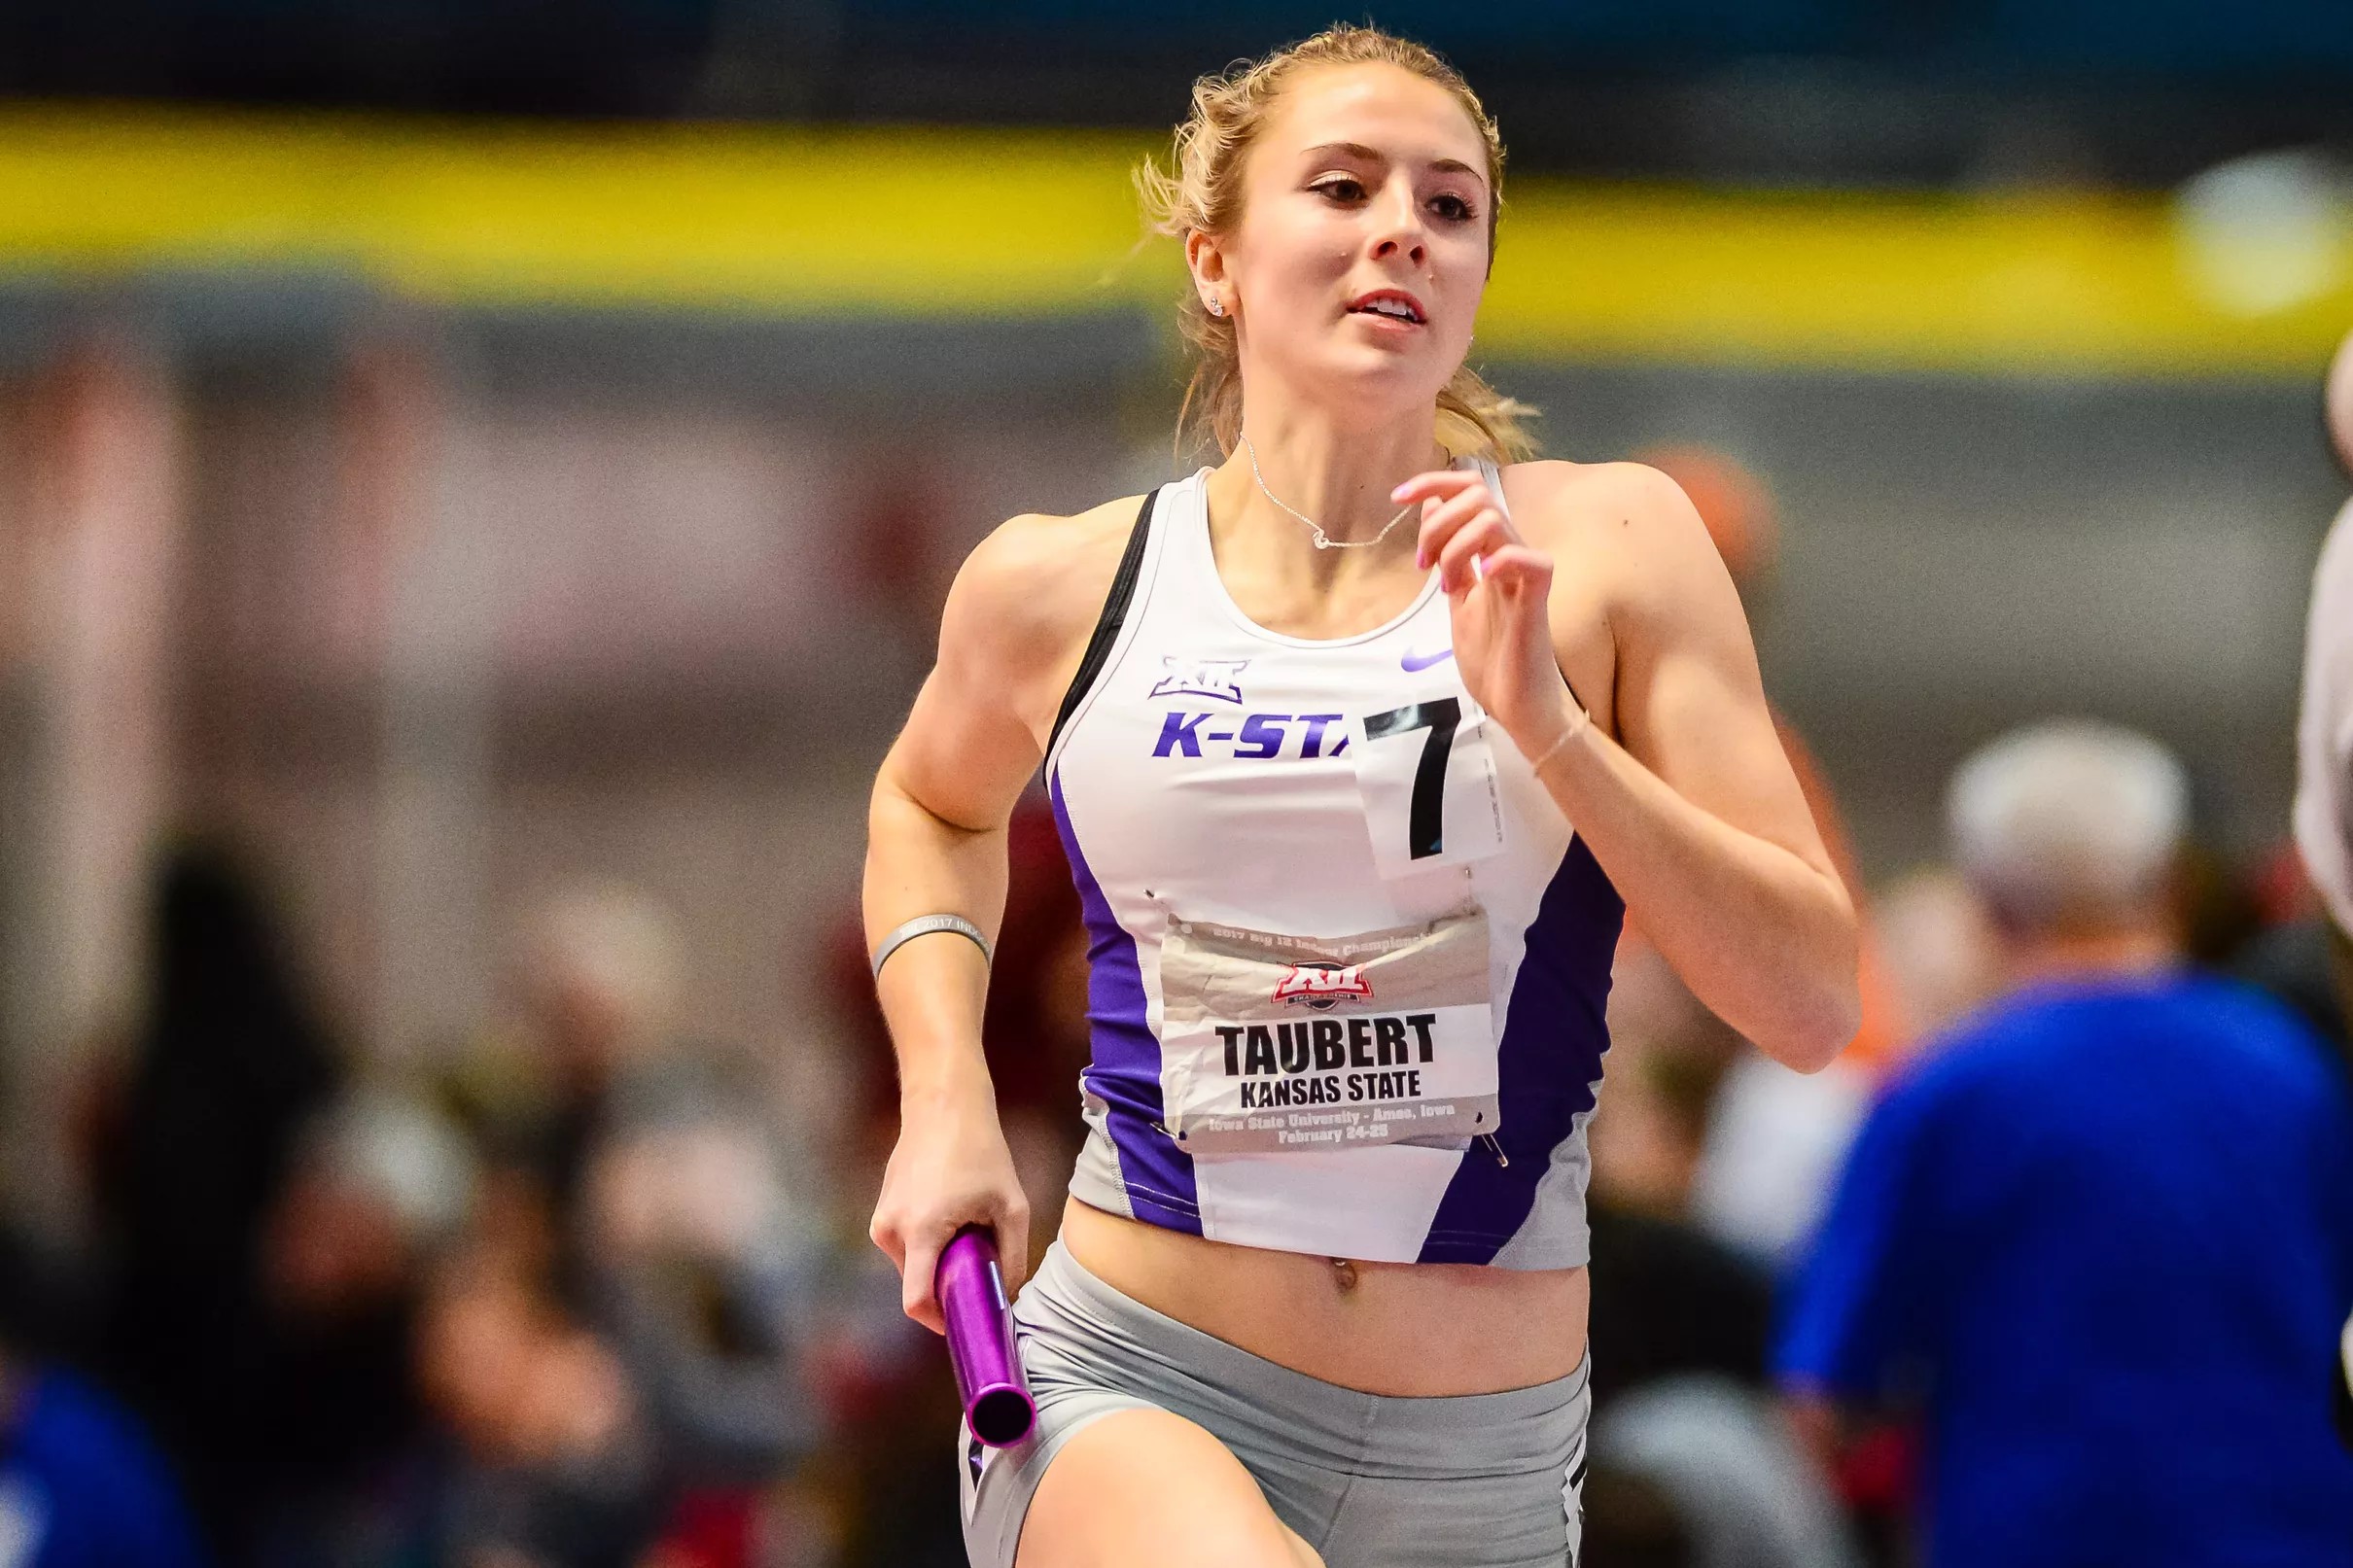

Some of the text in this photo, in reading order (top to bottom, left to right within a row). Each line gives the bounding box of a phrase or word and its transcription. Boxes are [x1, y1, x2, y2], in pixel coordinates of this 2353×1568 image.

[1363, 696, 1462, 859] 7
[1212, 927, 1245, 940] 2017
[1277, 936, 1292, 947] 12
[1214, 1013, 1436, 1076] TAUBERT
[1240, 1069, 1422, 1108] KANSAS STATE
[1209, 1118, 1244, 1132] Iowa
[1247, 1116, 1284, 1130] State
[1288, 1111, 1360, 1127] University
[1421, 1104, 1455, 1117] Iowa
[1278, 1128, 1342, 1143] February
